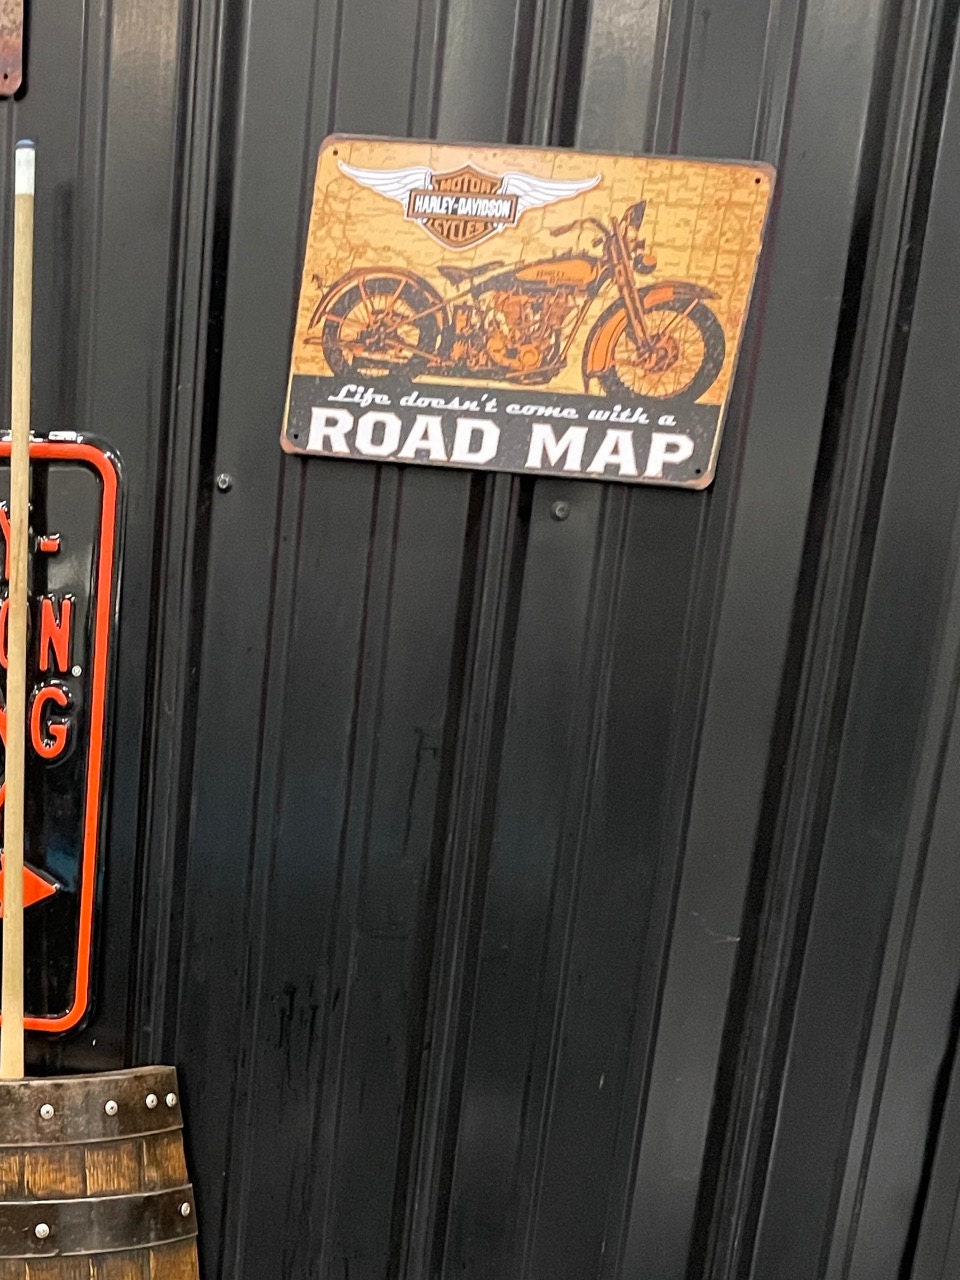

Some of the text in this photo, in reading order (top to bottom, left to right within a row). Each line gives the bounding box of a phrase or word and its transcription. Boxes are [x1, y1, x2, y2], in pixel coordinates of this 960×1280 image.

[440, 173, 492, 194] MOTOR
[414, 194, 511, 217] HARLEY-DAVIDSON
[434, 219, 485, 241] CYCLES
[328, 384, 677, 427] Life doesn't come with a
[306, 406, 695, 479] ROAD MAP
